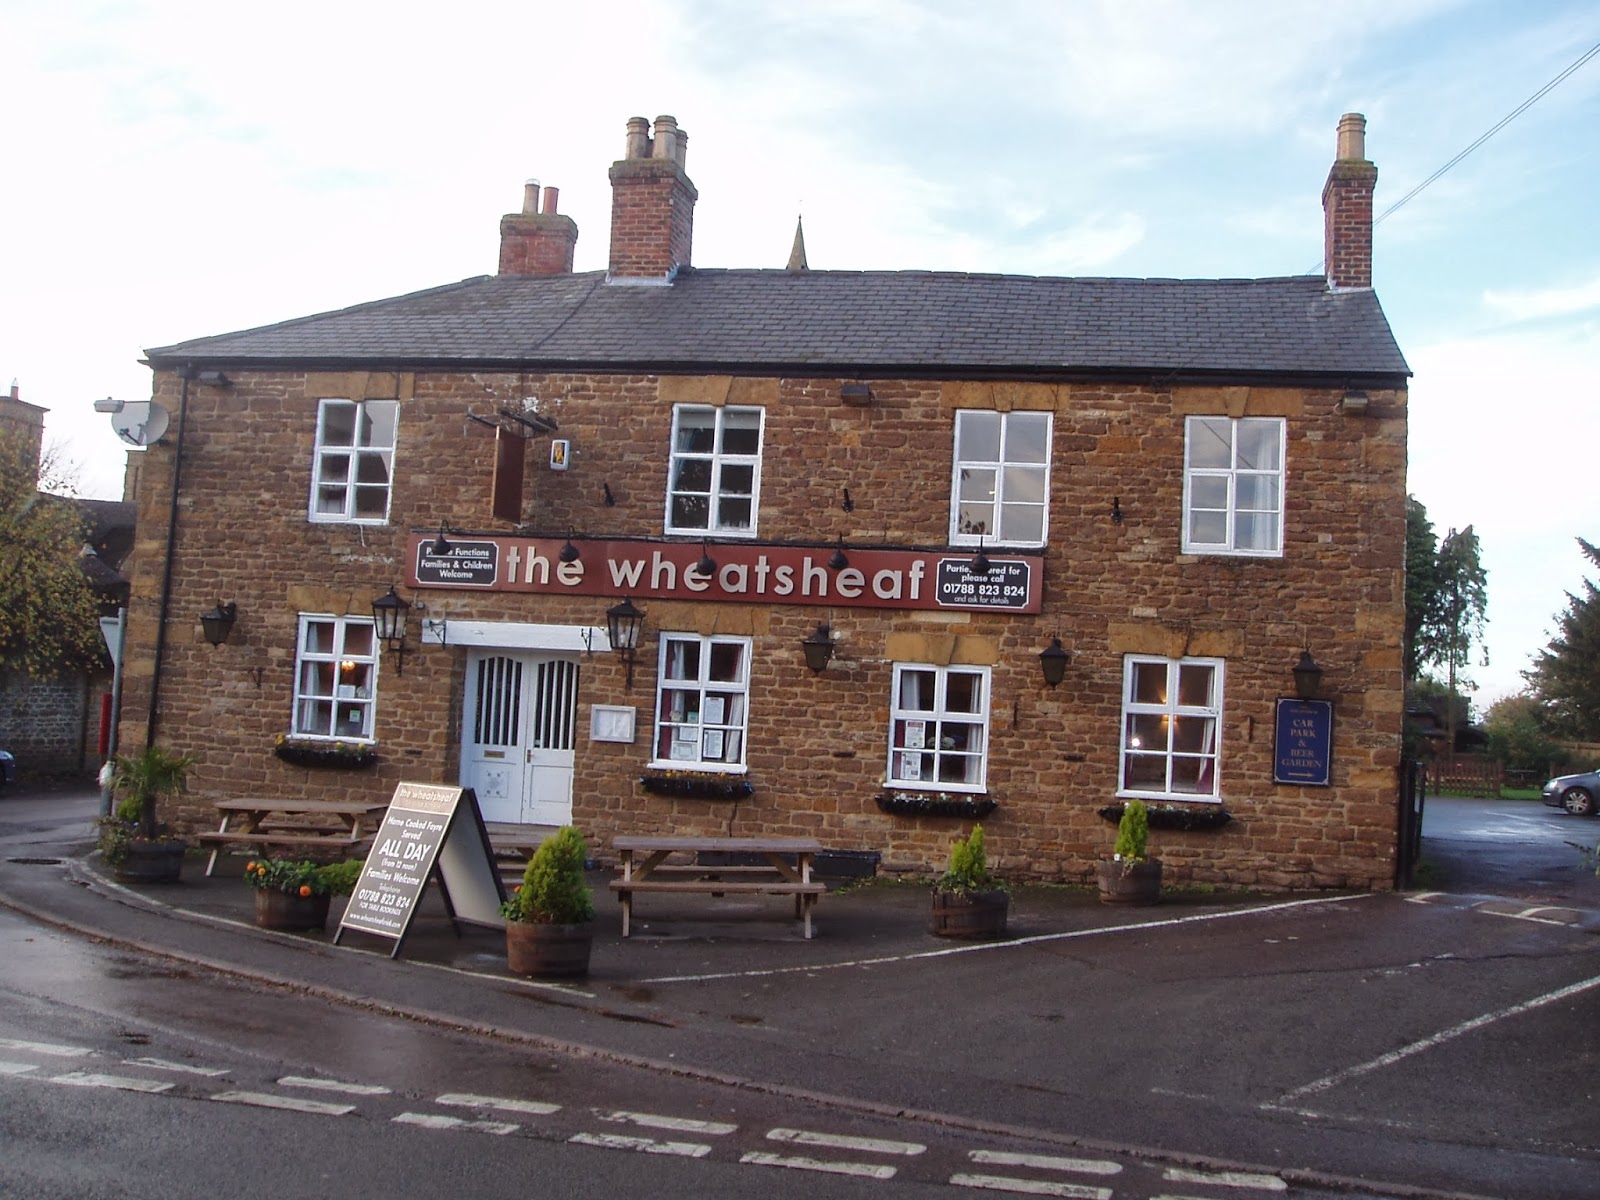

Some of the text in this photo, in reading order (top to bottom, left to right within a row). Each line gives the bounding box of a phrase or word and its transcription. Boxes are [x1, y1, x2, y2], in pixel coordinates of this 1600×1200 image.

[455, 548, 490, 557] Functions
[421, 560, 493, 570] Families & Children
[946, 564, 972, 573] Partie
[1008, 566, 1020, 576] for
[439, 569, 473, 579] Welcome
[506, 546, 924, 599] the wheatsheaf
[961, 573, 1005, 583] please call
[943, 583, 1025, 597] 01788 823 824
[954, 595, 1010, 605] and ask for details
[1293, 719, 1314, 728] CAR
[1290, 729, 1316, 738] PARK
[1298, 739, 1306, 748] &
[1290, 748, 1314, 758] BEER
[1281, 758, 1322, 768] GARDEN
[387, 816, 404, 827] Home
[405, 818, 428, 830] Cooked
[401, 829, 422, 840] Served
[378, 839, 432, 862] ALL DAY
[366, 867, 420, 886] Families Welcome
[358, 888, 411, 909] 01788 823 824
